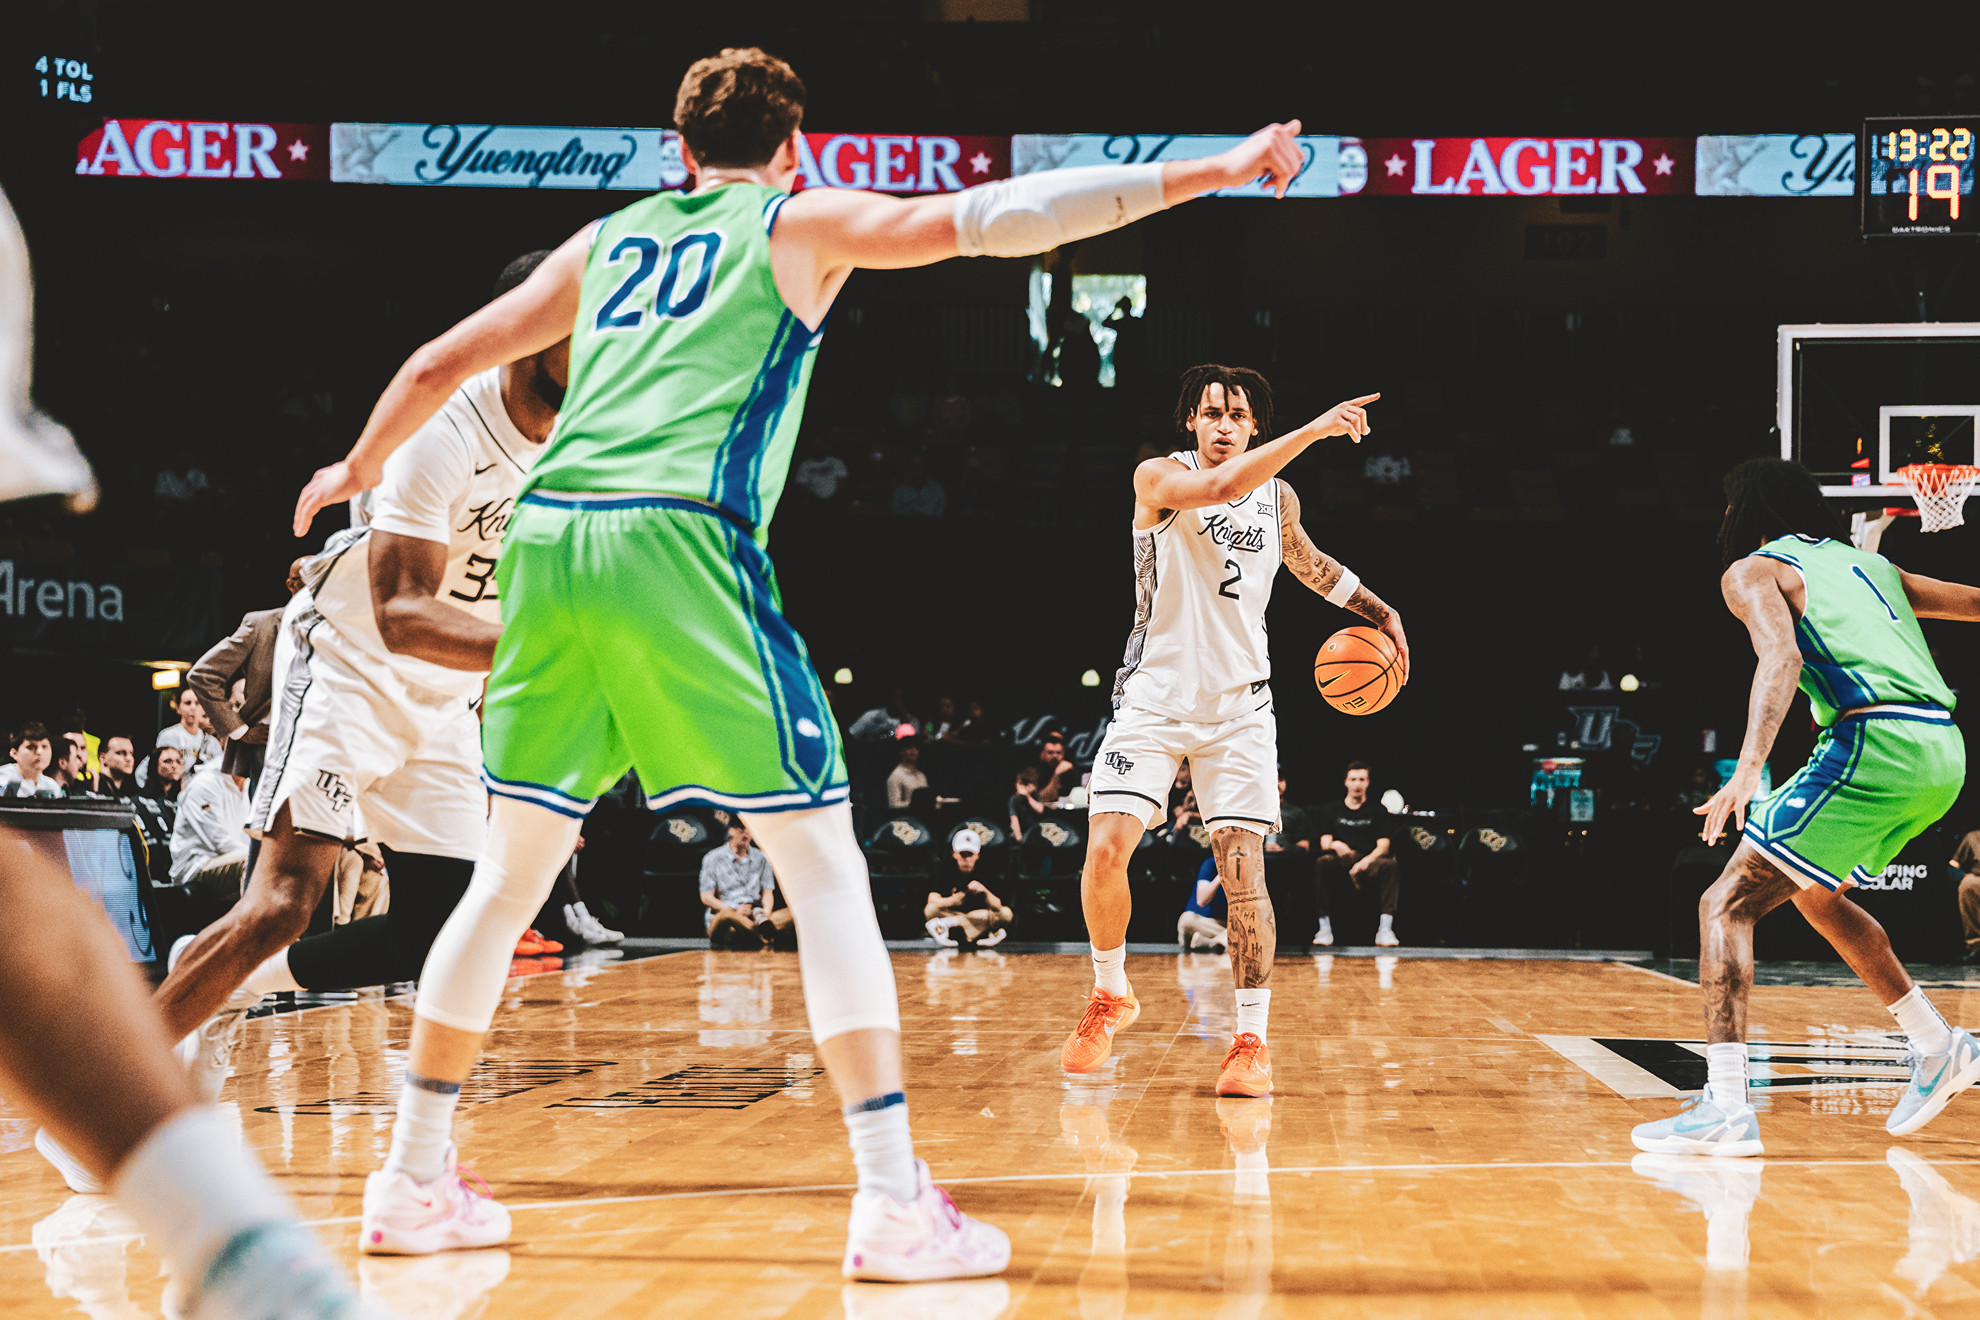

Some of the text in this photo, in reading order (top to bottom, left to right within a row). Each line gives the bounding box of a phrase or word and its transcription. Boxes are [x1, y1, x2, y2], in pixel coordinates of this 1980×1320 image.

[35, 55, 94, 81] 4 TOL
[39, 78, 93, 104] 1 FLS
[75, 119, 282, 179] AGER
[415, 124, 637, 190] Yuengling
[797, 134, 965, 191] AGER
[1411, 138, 1647, 195] LAGER
[1888, 127, 1971, 162] 13:22
[1908, 164, 1960, 221] 19
[589, 229, 728, 337] 20
[1197, 514, 1266, 552] Knights
[0, 559, 124, 623] Arena
[449, 552, 500, 602] 3
[1218, 558, 1242, 600] 2
[1849, 563, 1902, 623] 1
[1331, 695, 1368, 711] ELI
[1105, 751, 1134, 775] UCF
[316, 768, 352, 813] UCF
[1878, 864, 1928, 879] FING
